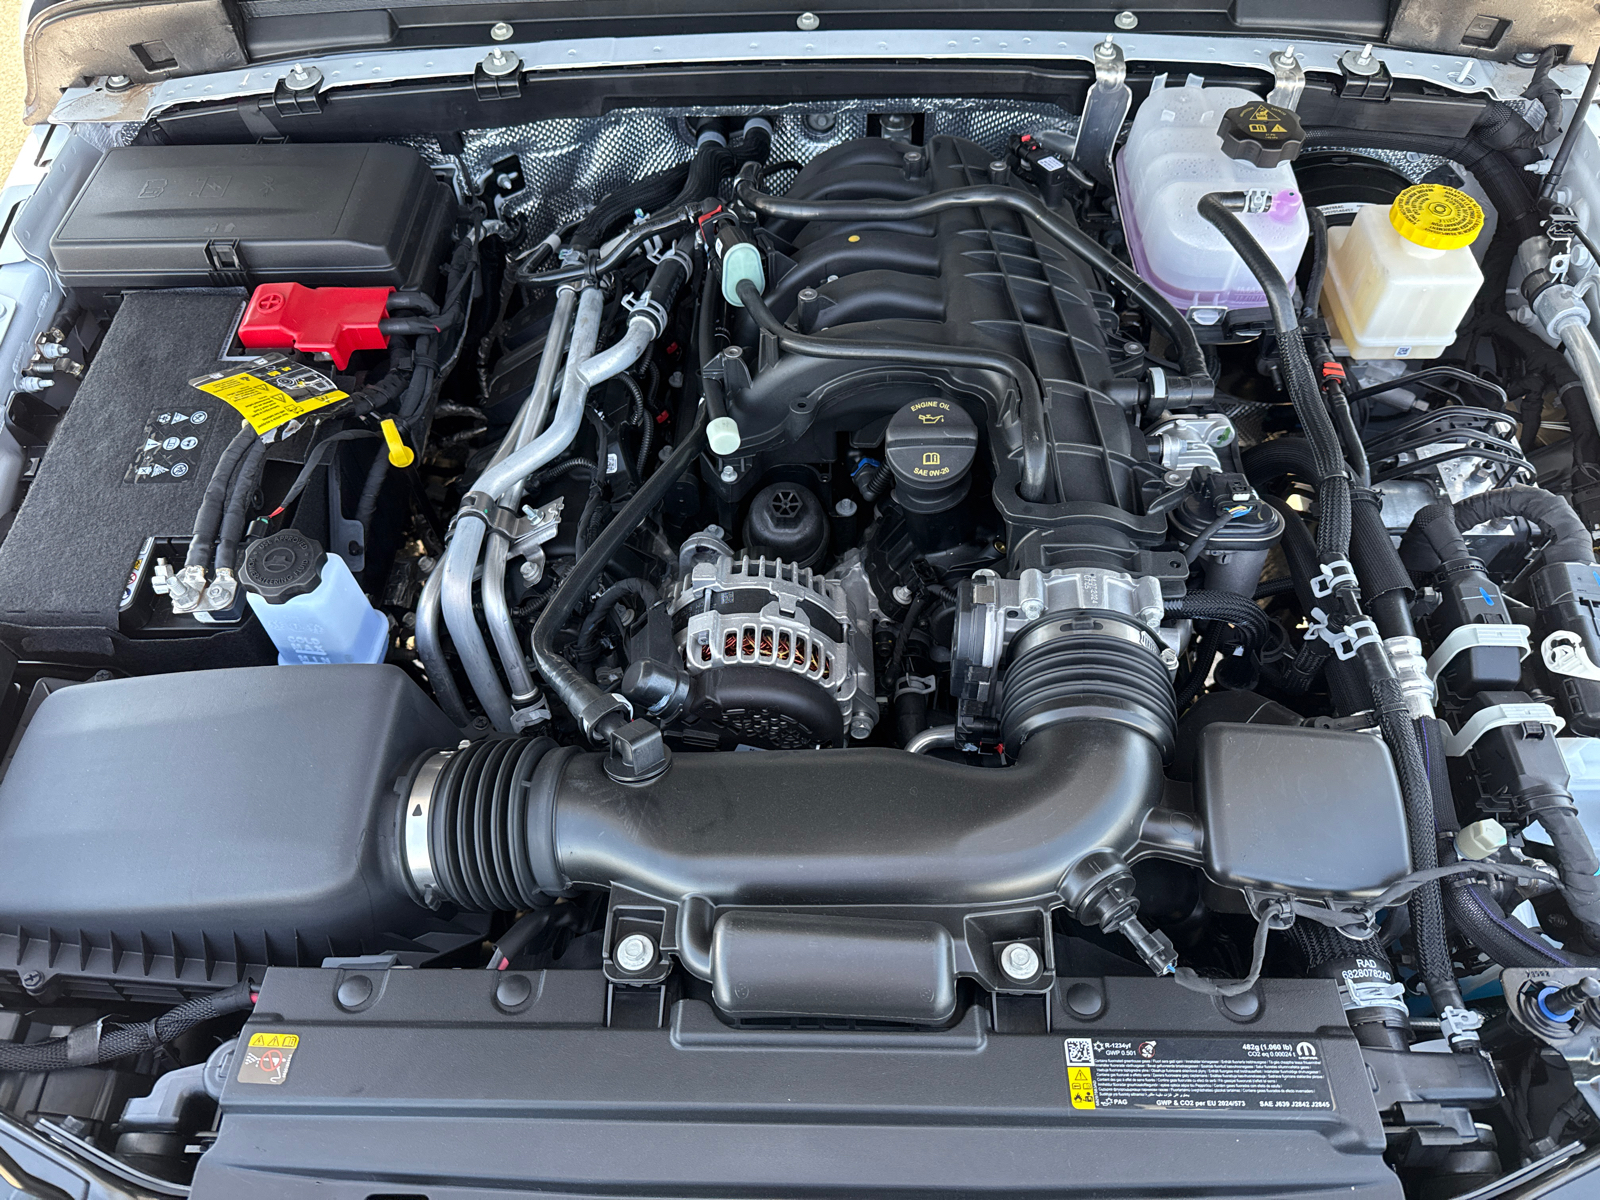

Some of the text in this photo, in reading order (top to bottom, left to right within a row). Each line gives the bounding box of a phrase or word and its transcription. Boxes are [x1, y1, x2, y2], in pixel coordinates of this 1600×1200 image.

[911, 401, 950, 412] ENGINE OIL
[914, 467, 949, 476] SAE 0W-20
[259, 536, 308, 550] USE APPROVED
[248, 557, 309, 585] POWER STEERING FLUID
[287, 636, 320, 645] COLD
[290, 643, 325, 653] MAX
[298, 655, 331, 664] MIN
[1356, 959, 1377, 968] RAD
[1342, 969, 1392, 981] 68280782AD
